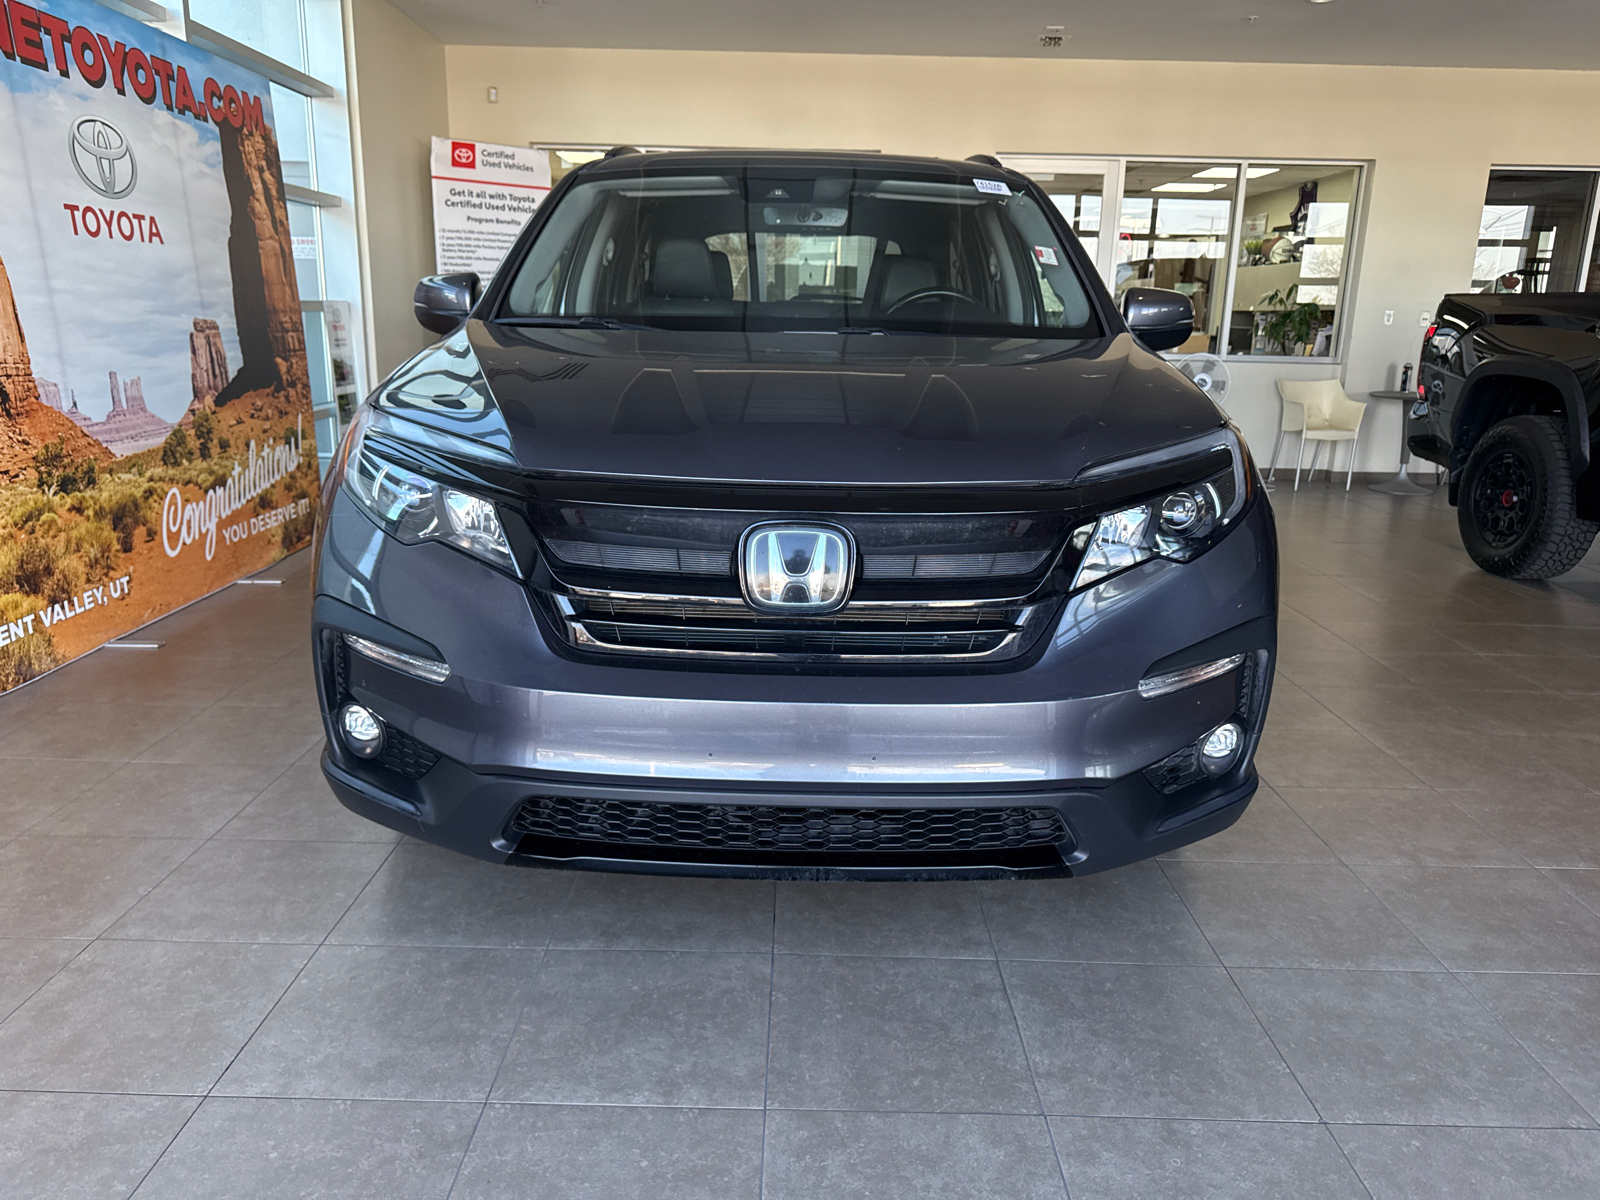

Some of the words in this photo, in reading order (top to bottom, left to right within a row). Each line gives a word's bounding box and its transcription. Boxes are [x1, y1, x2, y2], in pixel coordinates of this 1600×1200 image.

[481, 149, 515, 160] Certified
[481, 159, 502, 169] Used
[503, 161, 534, 172] Vehicles
[449, 188, 466, 198] Get
[467, 189, 474, 198] it
[475, 191, 487, 200] all
[488, 193, 507, 201] with
[508, 193, 535, 204] Toyota
[444, 198, 483, 210] Certified
[484, 202, 506, 211] Used
[63, 203, 164, 245] TOYOTA
[467, 215, 495, 224] Program
[496, 217, 521, 226] Benefits
[162, 412, 303, 562] Congratulations!
[222, 521, 248, 545] YOU
[249, 502, 297, 535] DESERVE
[297, 497, 311, 516] IT!
[38, 586, 108, 628] VALLEY,
[109, 576, 130, 600] UT
